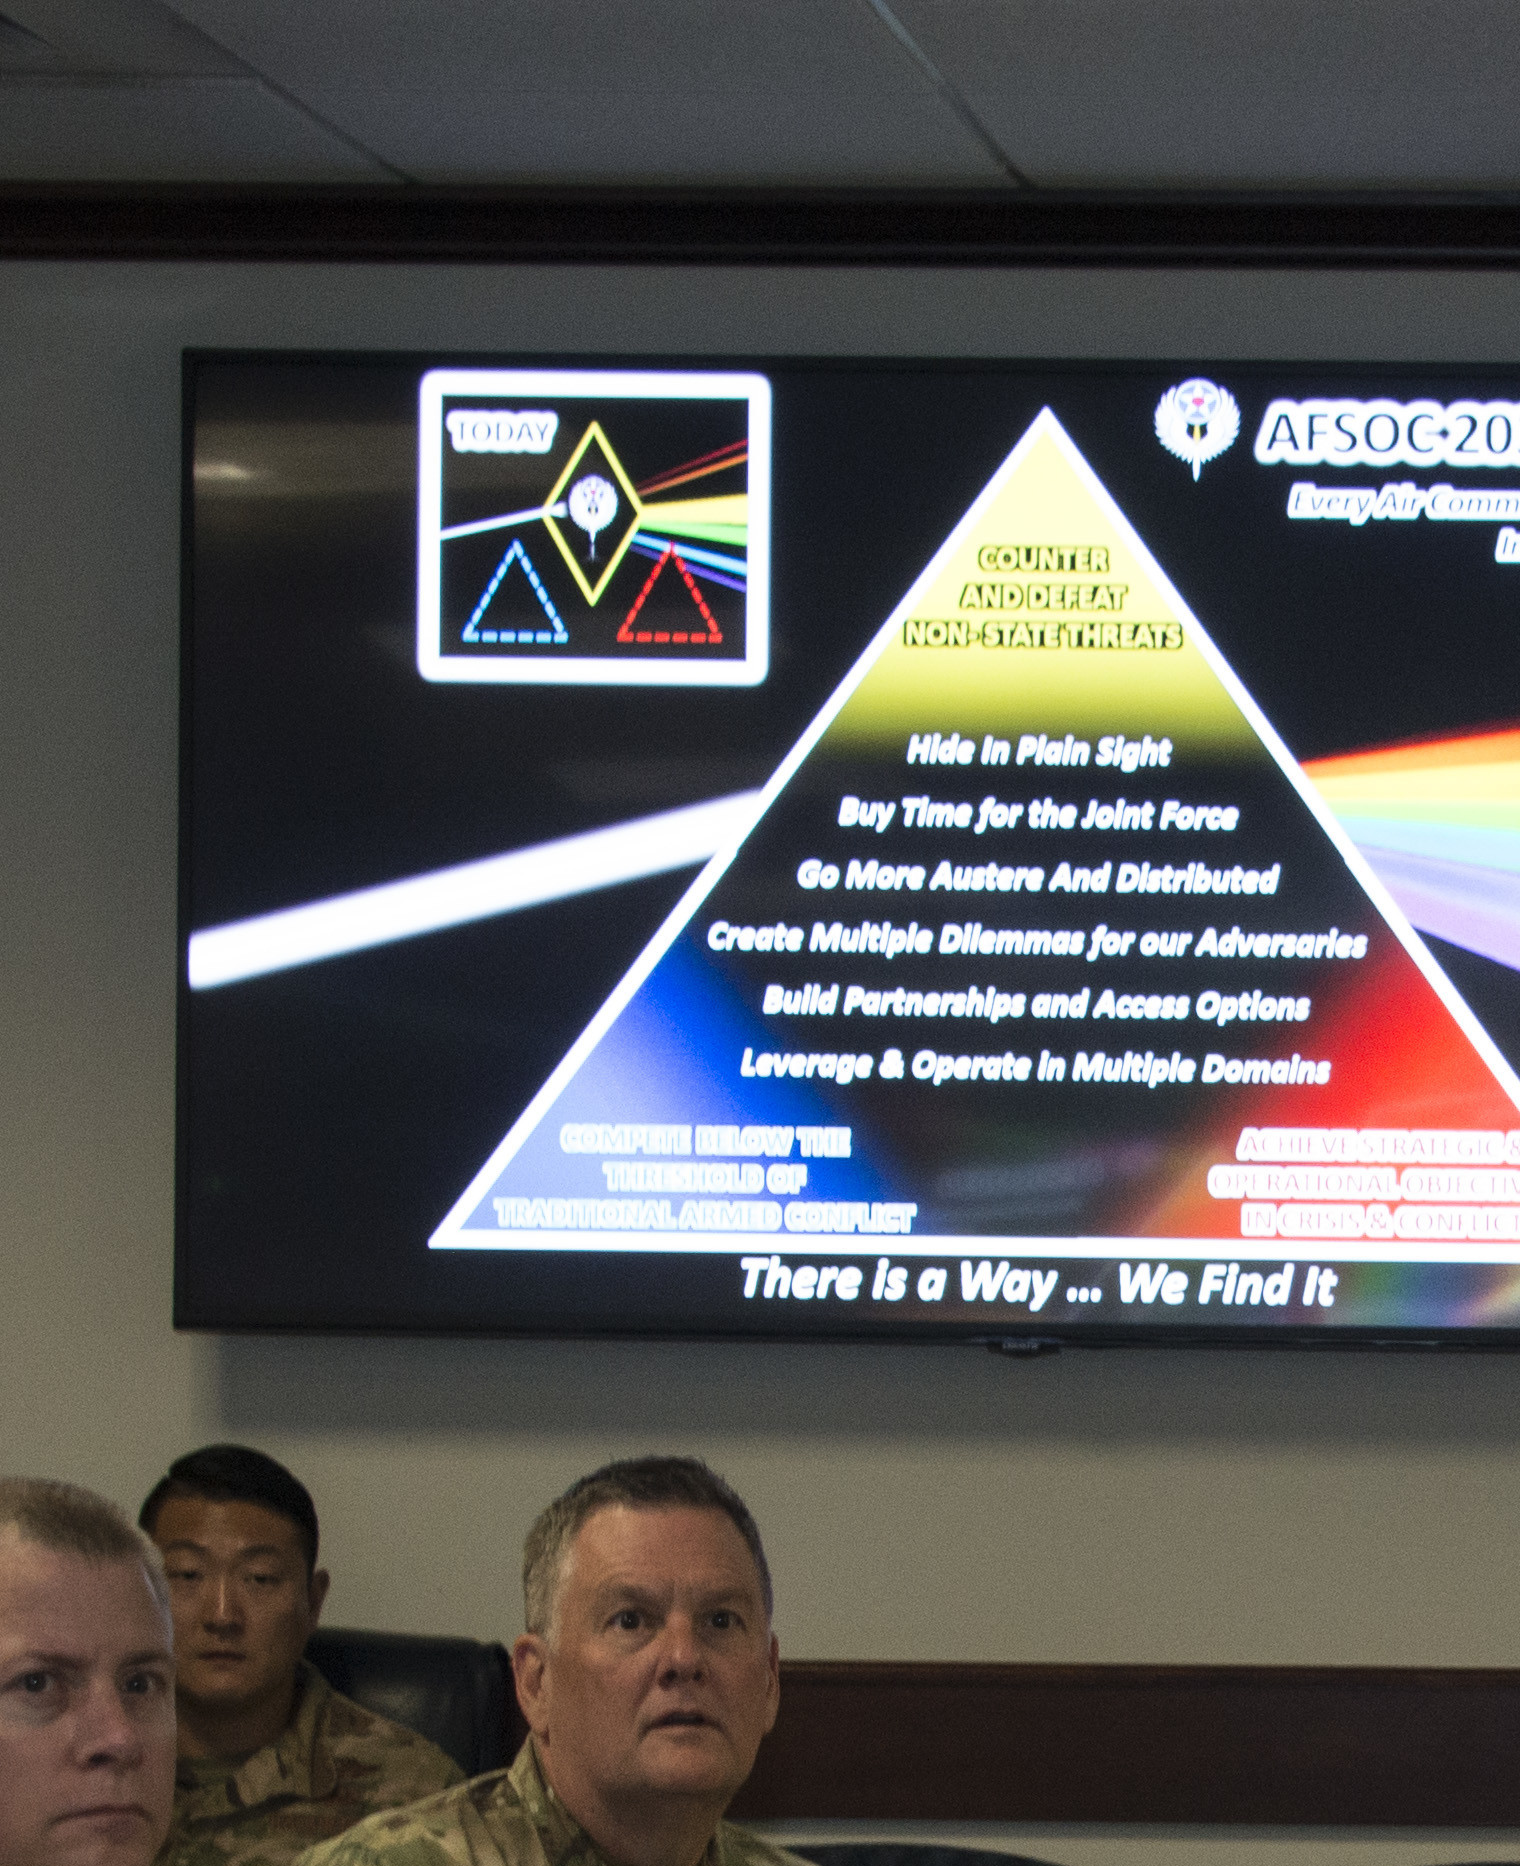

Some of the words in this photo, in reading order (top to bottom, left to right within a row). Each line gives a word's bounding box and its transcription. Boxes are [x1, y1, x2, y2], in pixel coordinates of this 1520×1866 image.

[452, 416, 554, 446] TODAY
[1290, 486, 1373, 520] Every
[1378, 486, 1423, 516] Air
[979, 546, 1109, 572] COUNTER
[960, 584, 1023, 610] AND
[1028, 585, 1127, 610] DEFEAT
[1065, 623, 1182, 650] THREATS
[907, 733, 975, 764] Hide
[981, 735, 1010, 765] In
[1016, 734, 1090, 766] Plain
[1095, 735, 1172, 772] Sight
[838, 797, 896, 832] Buy
[902, 796, 972, 827] Time
[974, 797, 1024, 834] for
[1029, 798, 1077, 829] the
[1081, 799, 1155, 830] Joint
[1160, 801, 1239, 830] Force
[798, 859, 840, 889] Go
[845, 860, 926, 890] More
[929, 861, 1044, 891] Austere
[1049, 862, 1111, 892] And
[1116, 862, 1280, 894] Distributed
[708, 921, 804, 951] Create
[809, 922, 933, 959] Multiple
[939, 923, 1085, 955] Dilemmas
[1086, 925, 1136, 961] for
[1140, 932, 1192, 956] our
[1195, 926, 1368, 958] Adversaries
[763, 984, 839, 1015] Build
[843, 986, 1026, 1023] Partnerships
[1032, 988, 1090, 1018] and
[1093, 990, 1190, 1019] Access
[1196, 990, 1310, 1026] Options
[741, 1048, 873, 1084] Leverage
[879, 1049, 904, 1078] &
[912, 1050, 1032, 1085] Operate
[1037, 1050, 1066, 1081] in
[1072, 1051, 1196, 1088] Multiple
[1202, 1054, 1331, 1084] Domains
[560, 1123, 692, 1155] COMPETE
[695, 1125, 793, 1156] BELOW
[796, 1126, 852, 1158] THE
[1239, 1130, 1351, 1160] ACHIEVE
[1359, 1132, 1502, 1162] STRATEGIC
[602, 1161, 764, 1193] THRESHOLD
[766, 1163, 808, 1194] OF
[1209, 1167, 1398, 1197] OPERATIONAL
[493, 1198, 677, 1230] TRADITIONAL
[679, 1200, 781, 1231] ARMED
[784, 1202, 917, 1233] CONFLICT
[1242, 1206, 1275, 1233] IN
[1278, 1206, 1363, 1234] CRISIS
[741, 1255, 862, 1300] There
[872, 1258, 907, 1301] is
[918, 1268, 947, 1301] a
[961, 1261, 1058, 1311] Way
[1119, 1263, 1188, 1305] We
[1199, 1263, 1295, 1306] Find
[1303, 1266, 1338, 1307] It
